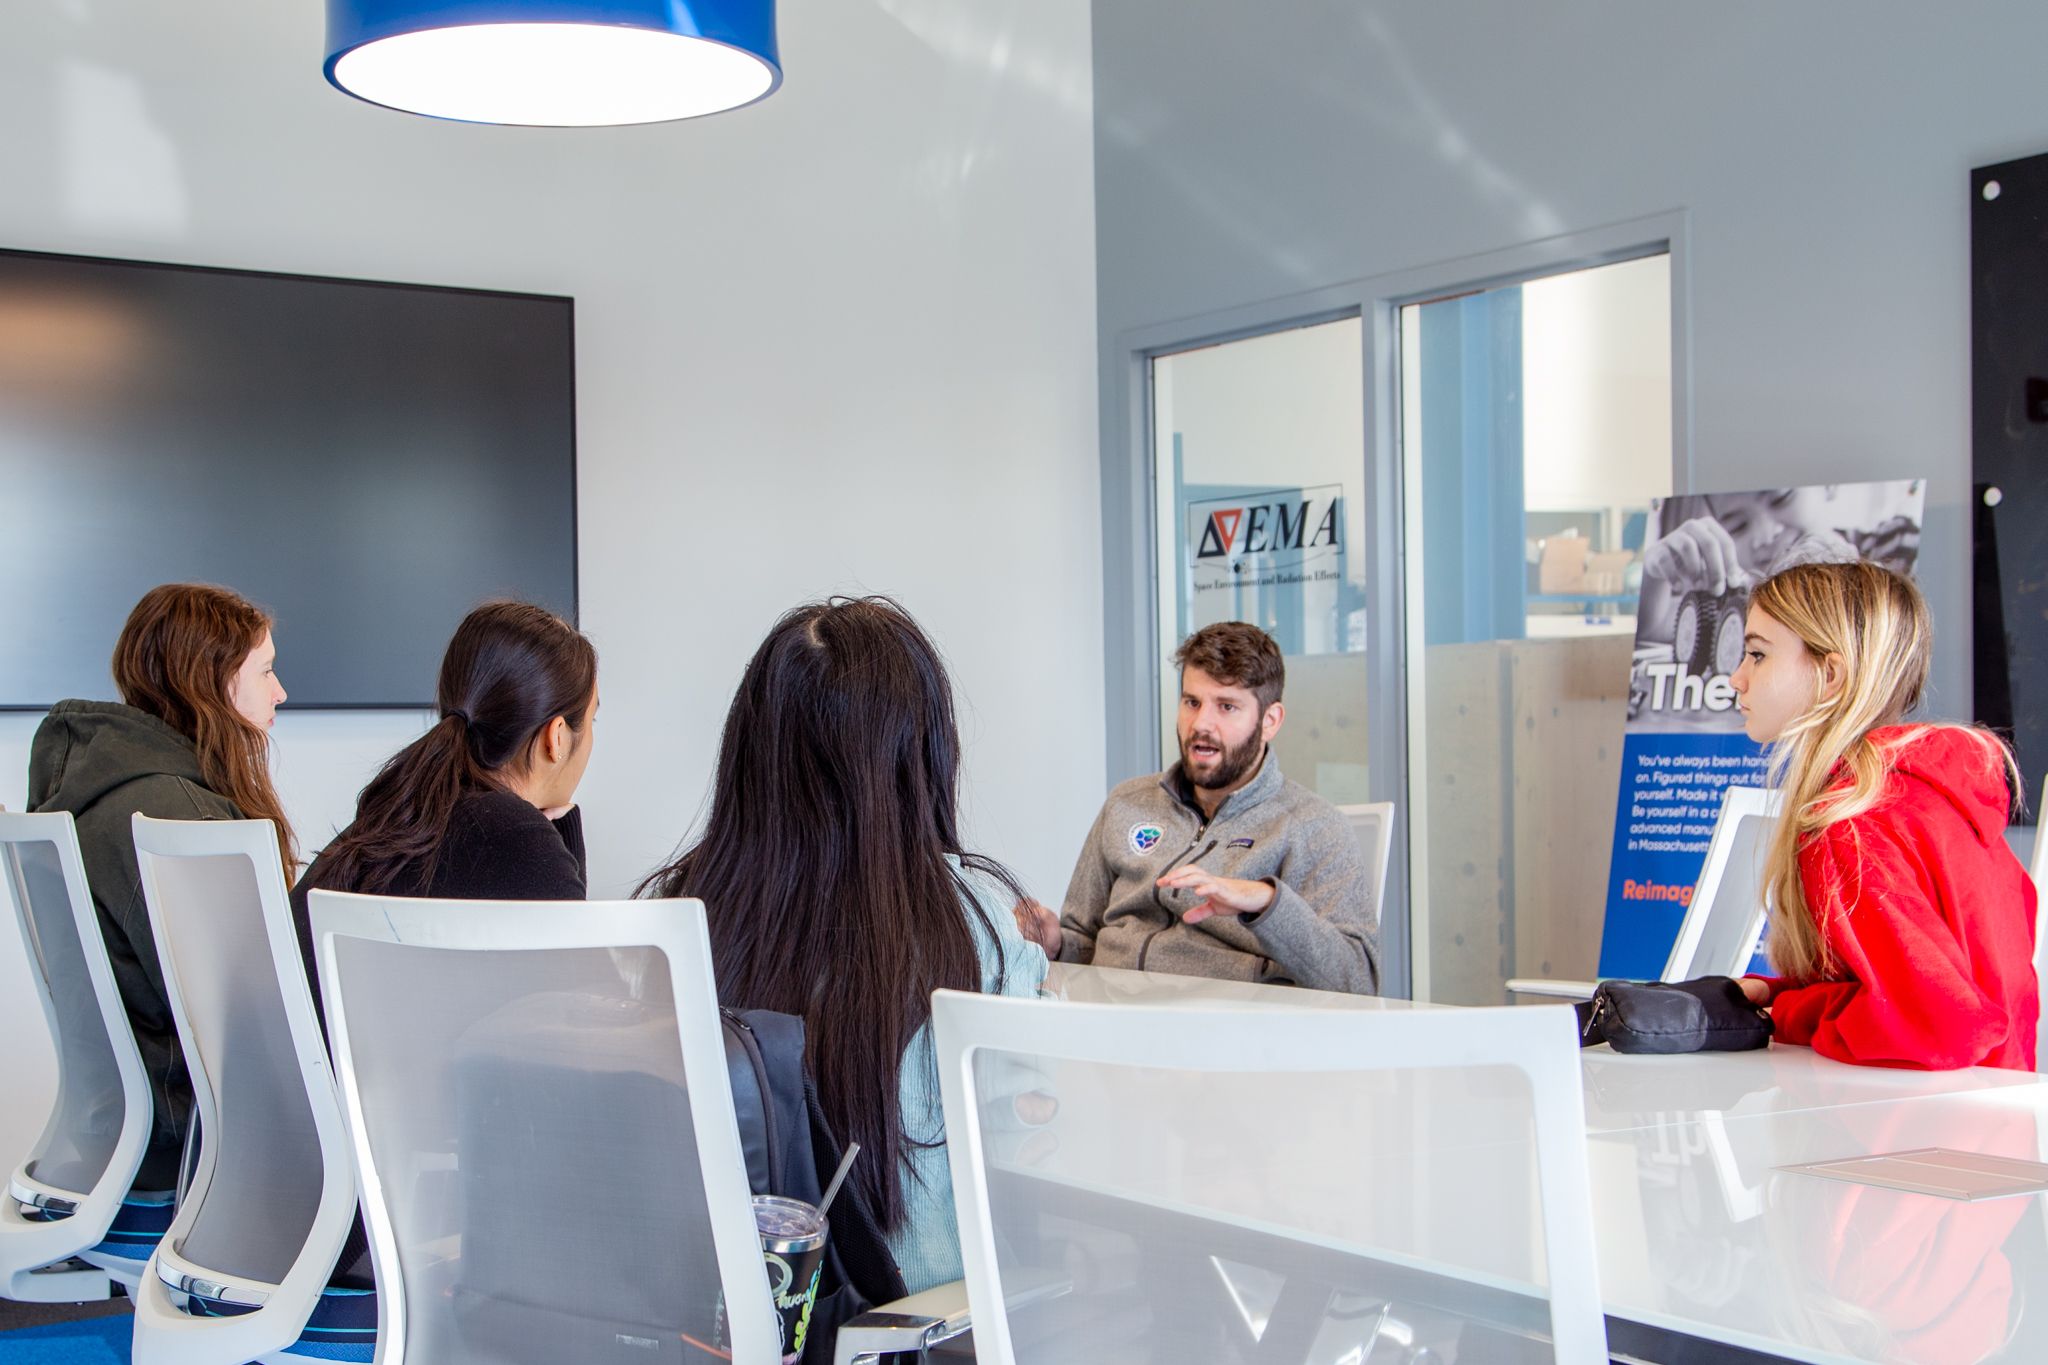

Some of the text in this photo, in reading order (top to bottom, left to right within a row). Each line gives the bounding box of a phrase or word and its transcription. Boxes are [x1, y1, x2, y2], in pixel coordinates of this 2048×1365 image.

[1193, 570, 1341, 594] Space Environment and Radiation Effects
[1647, 663, 1743, 712] The
[1638, 755, 1771, 769] You've always been hand
[1635, 773, 1650, 783] on.
[1652, 772, 1693, 786] Figured
[1694, 772, 1728, 786] things
[1730, 774, 1749, 784] out
[1634, 788, 1675, 802] yourself.
[1676, 788, 1708, 801] Made
[1709, 789, 1718, 801] it
[1632, 804, 1645, 817] Be
[1646, 805, 1687, 819] yourself
[1688, 805, 1698, 818] in
[1700, 809, 1709, 818] a
[1630, 823, 1714, 836] advanced manu
[1628, 839, 1710, 853] in Massachusett
[1623, 879, 1697, 907] Reimag
